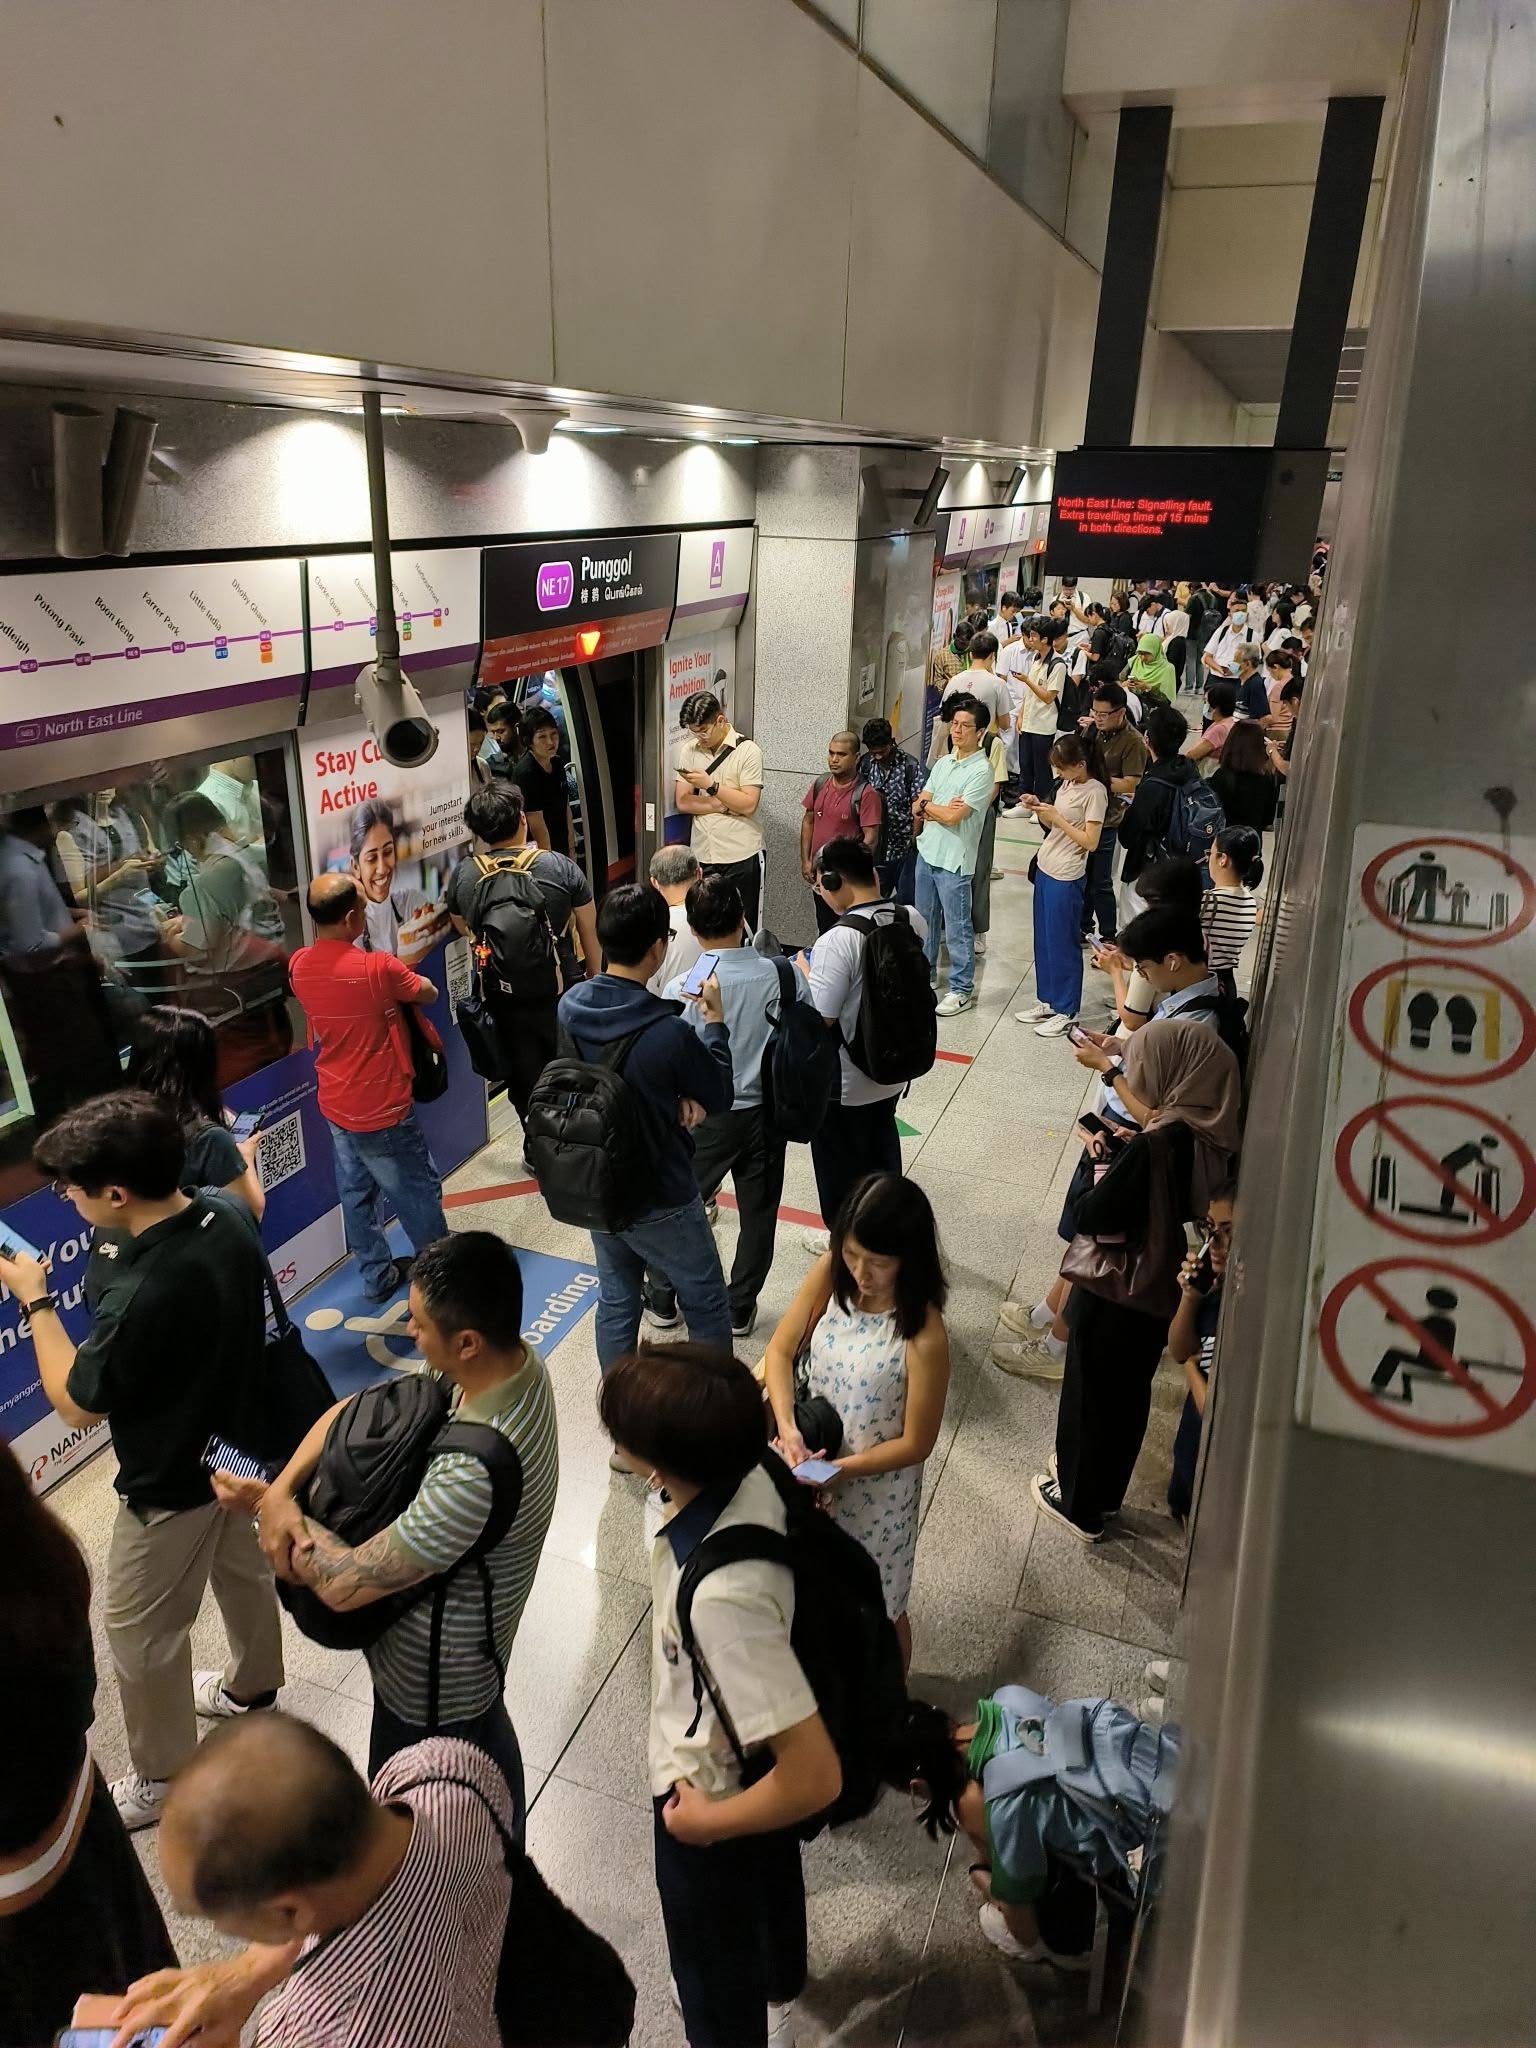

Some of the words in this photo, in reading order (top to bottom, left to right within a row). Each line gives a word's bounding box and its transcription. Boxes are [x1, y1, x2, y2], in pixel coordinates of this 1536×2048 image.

[1058, 497, 1084, 507] North
[1086, 498, 1108, 508] East
[1111, 498, 1135, 509] Line:
[1137, 499, 1186, 511] Signalling
[1188, 500, 1213, 511] fault.
[1060, 509, 1085, 519] Extra
[1088, 511, 1130, 522] travelling
[1133, 511, 1154, 522] time
[1156, 512, 1168, 522] of
[1170, 512, 1182, 523] 15
[1184, 513, 1208, 524] mins
[1079, 522, 1088, 532] in
[1091, 522, 1111, 532] both
[1114, 523, 1163, 534] directions.
[581, 550, 632, 583] Punggol
[142, 591, 164, 617] Farrer
[163, 615, 180, 636] Park
[189, 590, 206, 612] Little
[206, 610, 222, 631] India
[231, 578, 250, 605] Dhoby
[250, 602, 267, 625] Ghaut
[34, 593, 64, 628] Potong
[64, 624, 85, 646] Pasir
[94, 596, 116, 622] Boon
[115, 618, 135, 643] Keng
[0, 621, 30, 654] odleigh
[669, 658, 693, 678] Ignite
[694, 653, 711, 669] Your
[669, 677, 706, 701] Ambition
[45, 718, 83, 737] North
[88, 713, 113, 729] East
[118, 708, 143, 723] Line
[315, 748, 357, 777] Stay
[320, 781, 378, 815] Active
[429, 796, 462, 816] Jumpstart
[422, 822, 438, 836] your
[422, 838, 433, 850] for
[433, 834, 447, 847] new
[448, 825, 464, 840] skills
[520, 1272, 600, 1346] oarding
